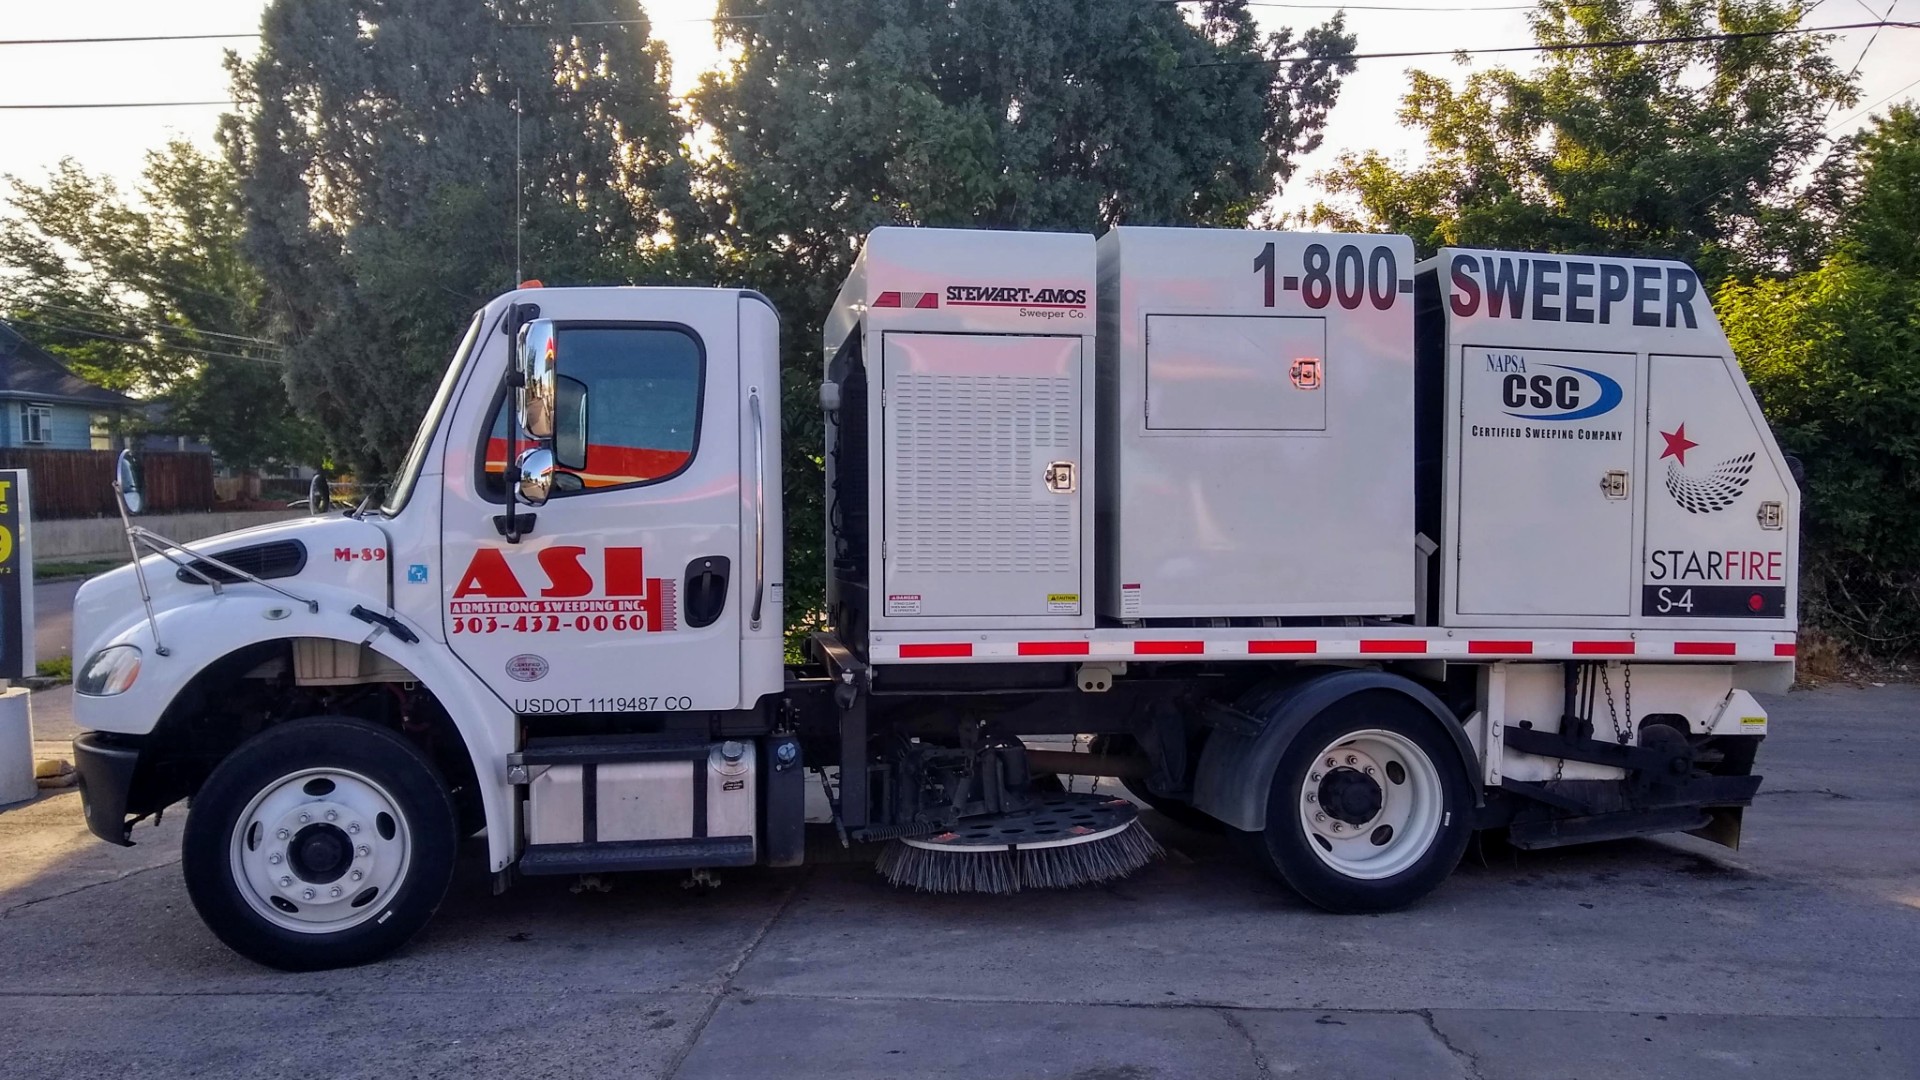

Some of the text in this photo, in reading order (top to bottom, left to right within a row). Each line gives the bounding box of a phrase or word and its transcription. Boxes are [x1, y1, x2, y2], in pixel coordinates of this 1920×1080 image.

[1253, 242, 1698, 329] 1-800- SWEEPER
[946, 286, 1086, 304] STEWART-AMOS
[1019, 308, 1065, 319] Sweeper
[1486, 354, 1526, 373] NAPSA
[1503, 374, 1579, 409] CSC
[1472, 425, 1622, 441] CERTIFIED SWEEPING COMPANY
[334, 547, 385, 562] M-89
[1650, 550, 1782, 580] STARFIRE
[452, 600, 645, 613] ARMSTRONG SWEEPING INC.
[1657, 587, 1693, 613] S-4
[453, 615, 644, 633] 303-432-0060
[515, 696, 692, 713] USDOT 1119487 CO
